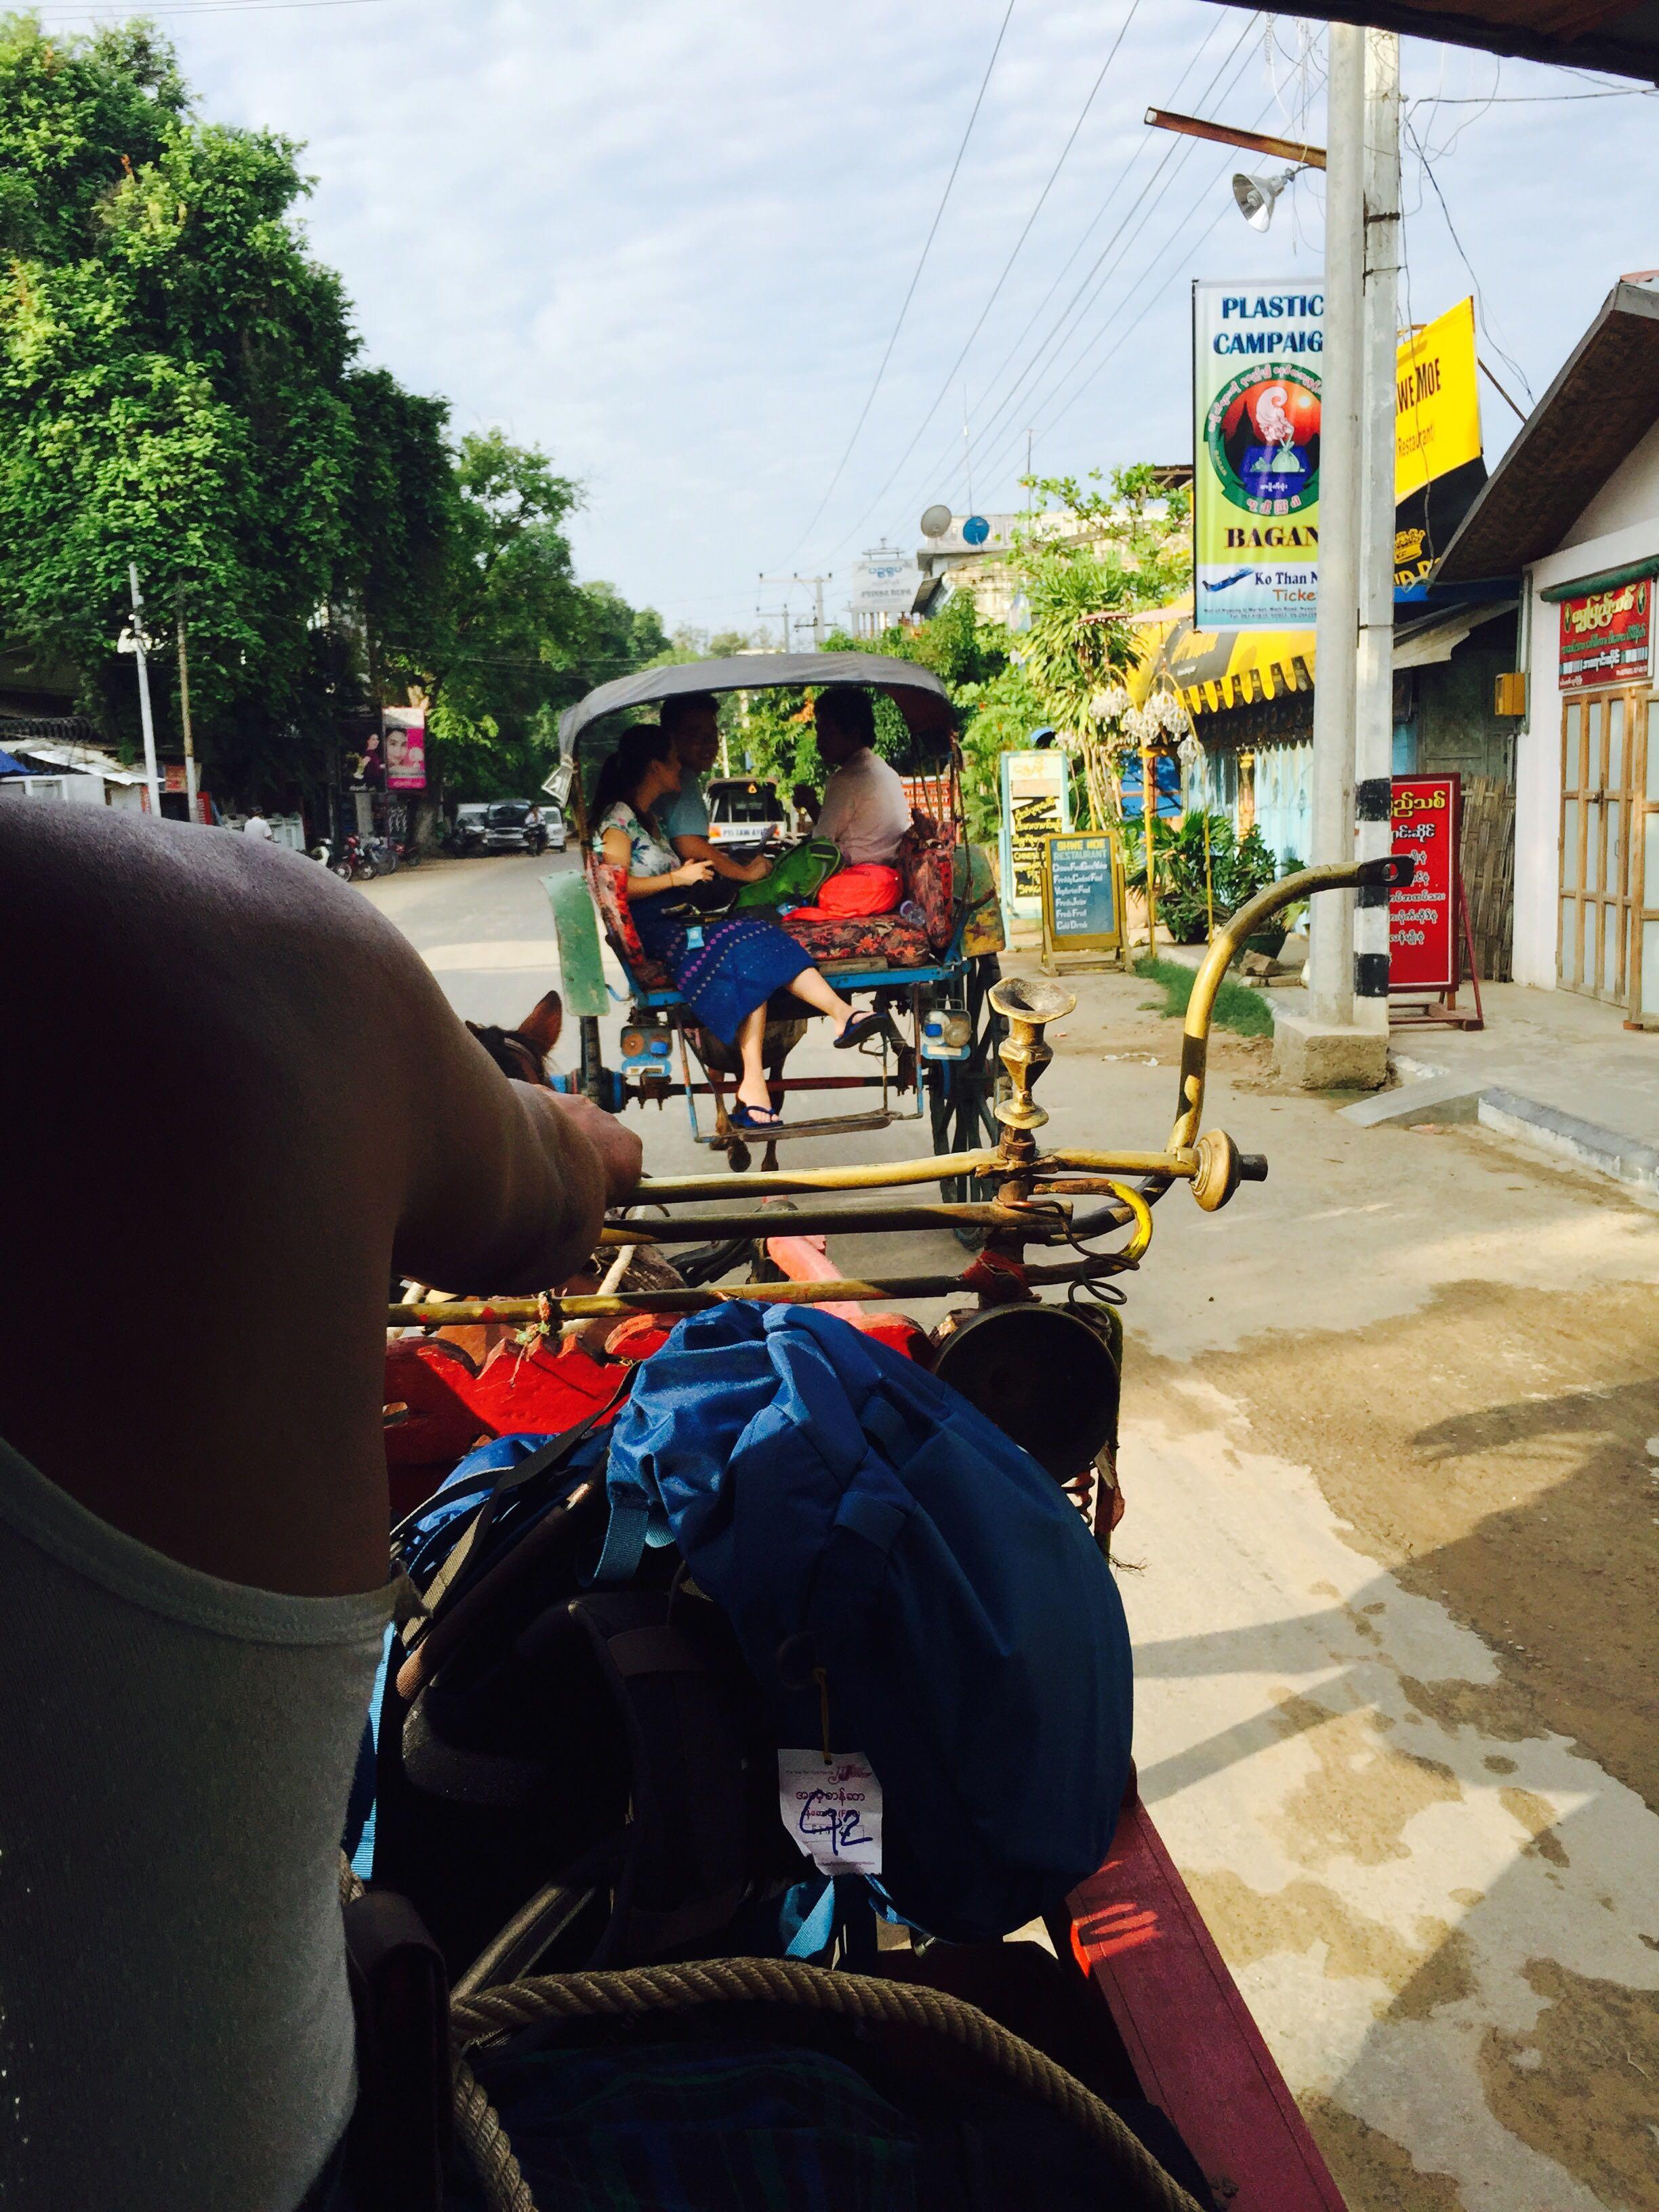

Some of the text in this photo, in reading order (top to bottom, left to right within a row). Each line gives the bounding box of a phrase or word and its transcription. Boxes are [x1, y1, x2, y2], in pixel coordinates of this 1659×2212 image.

[1222, 294, 1324, 319] PLASTIC
[1213, 330, 1323, 354] CAMPAIG
[1416, 358, 1441, 403] MOE
[1225, 526, 1319, 550] BAGAN
[1254, 572, 1272, 586] Ko
[1275, 572, 1307, 585] Than
[1272, 588, 1317, 602] Ticke
[1053, 849, 1107, 861] RESTAURANT
